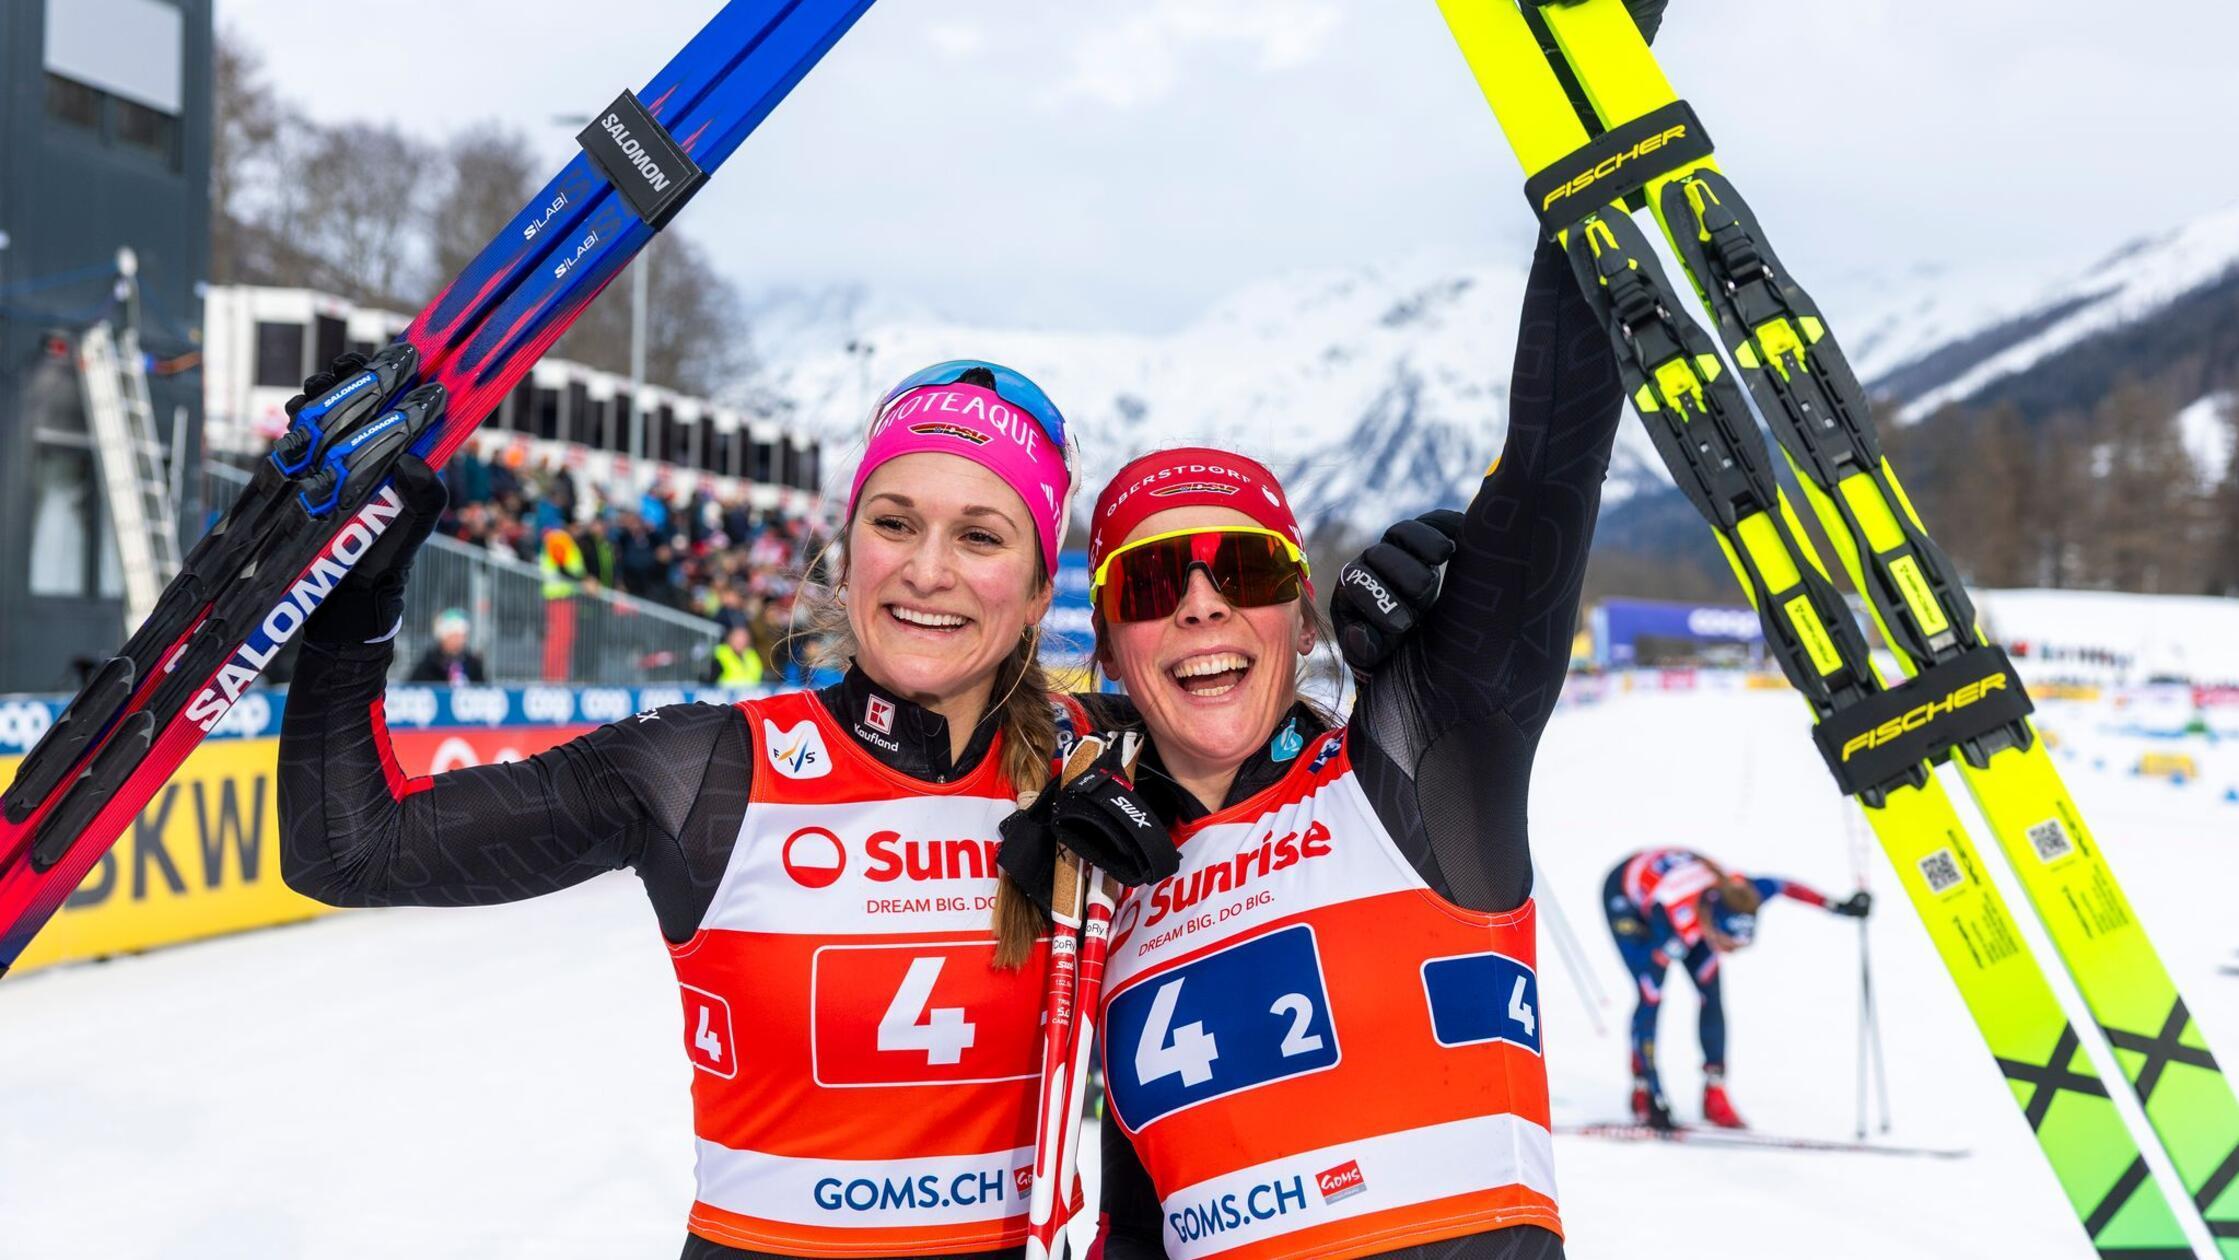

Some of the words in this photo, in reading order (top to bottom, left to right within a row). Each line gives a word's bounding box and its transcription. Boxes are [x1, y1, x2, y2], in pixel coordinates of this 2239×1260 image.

[601, 113, 670, 192] SALOMON
[1542, 124, 1686, 212] FISCHER
[324, 375, 371, 407] SALOMON
[350, 414, 399, 446] SALOMON
[1107, 464, 1251, 517] OBERSTDORF
[184, 485, 404, 732] SALOMON
[854, 723, 899, 752] Kaufland
[1842, 672, 2007, 762] FISCHER
[864, 830, 999, 882] Sunr
[1144, 820, 1332, 927] Sunrise
[867, 898, 931, 914] DREAM
[936, 897, 970, 912] BIG.
[1138, 925, 1183, 957] DREAM
[1187, 913, 1216, 934] BIG.
[1219, 903, 1243, 922] DO
[1246, 890, 1275, 911] BIG.
[695, 1005, 722, 1063] 4
[877, 957, 976, 1065] 4
[1134, 976, 1219, 1088] 4
[1269, 992, 1324, 1058] 2
[1508, 975, 1535, 1037] 4
[814, 1169, 1004, 1212] GOMS.CH
[1169, 1174, 1307, 1244] GOMS.CH
